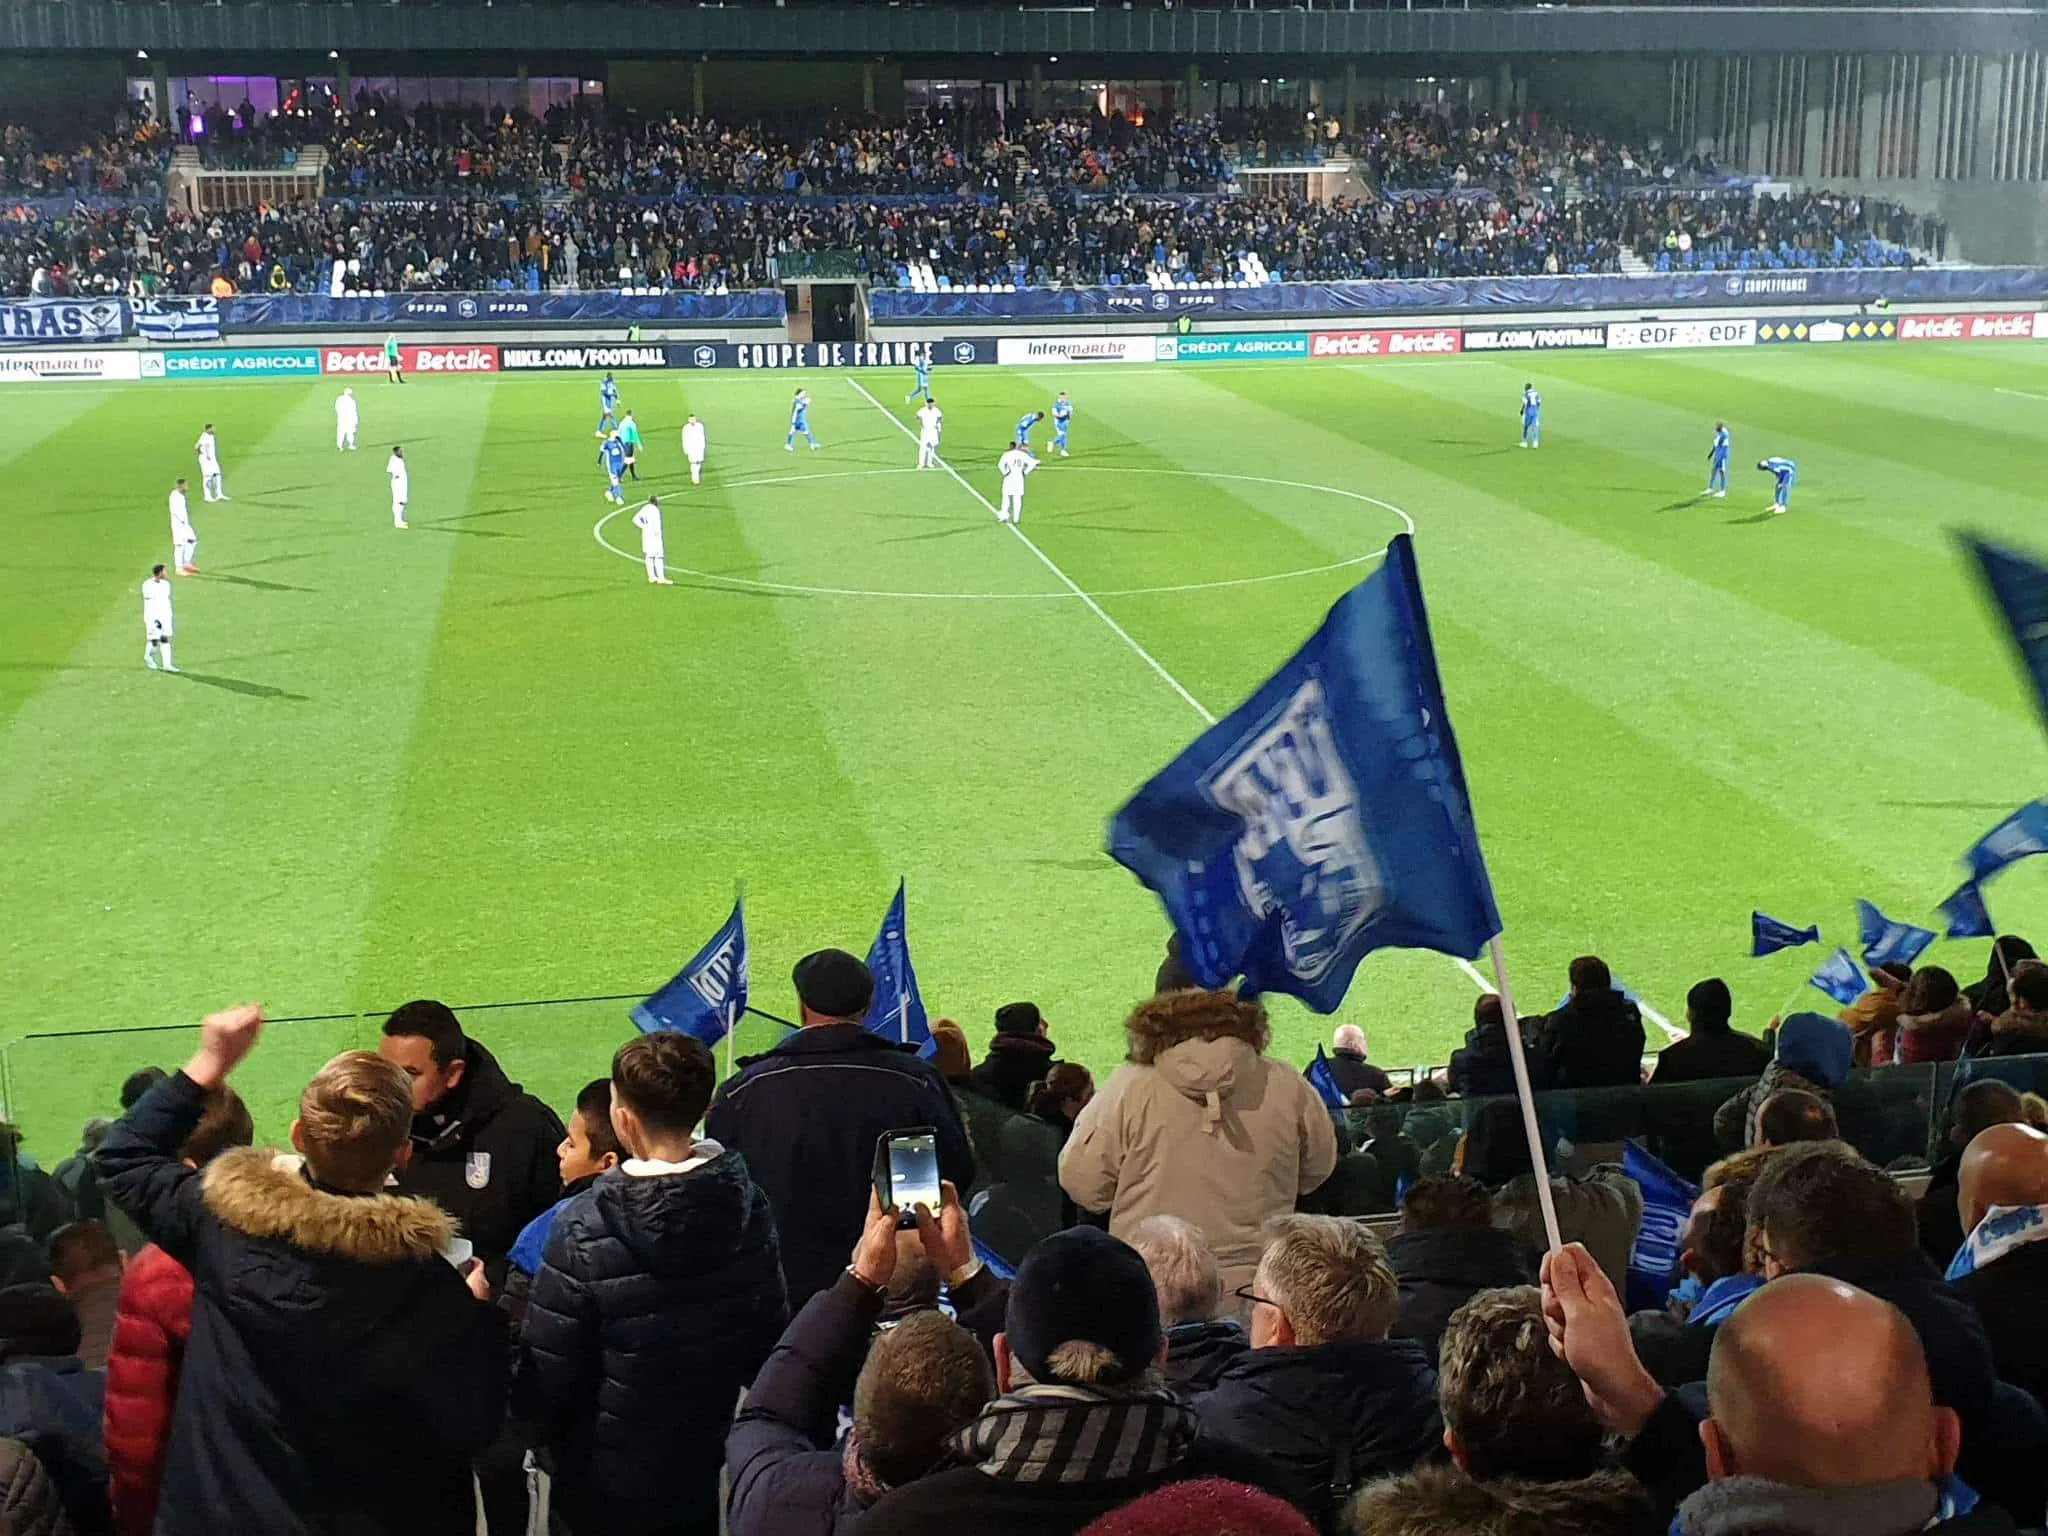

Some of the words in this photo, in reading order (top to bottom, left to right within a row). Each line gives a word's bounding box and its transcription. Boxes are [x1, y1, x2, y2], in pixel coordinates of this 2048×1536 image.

[129, 298, 164, 314] DK
[186, 297, 219, 313] 12
[1901, 318, 1964, 338] Betclic
[1970, 315, 2033, 336] Betclic
[1178, 340, 1231, 355] CRÉDIT
[1233, 340, 1306, 353] AGRICOLE
[1313, 333, 1382, 356] Betclic
[1388, 331, 1456, 353] Betclic
[166, 356, 226, 371] CRÉDIT
[231, 356, 317, 370] AGRICOLE
[415, 349, 493, 371] Betclic
[503, 348, 666, 368] NIKE.COM/FOOTBALL
[738, 344, 806, 368] COUPE
[818, 343, 844, 367] DE
[854, 342, 934, 366] FRANCE
